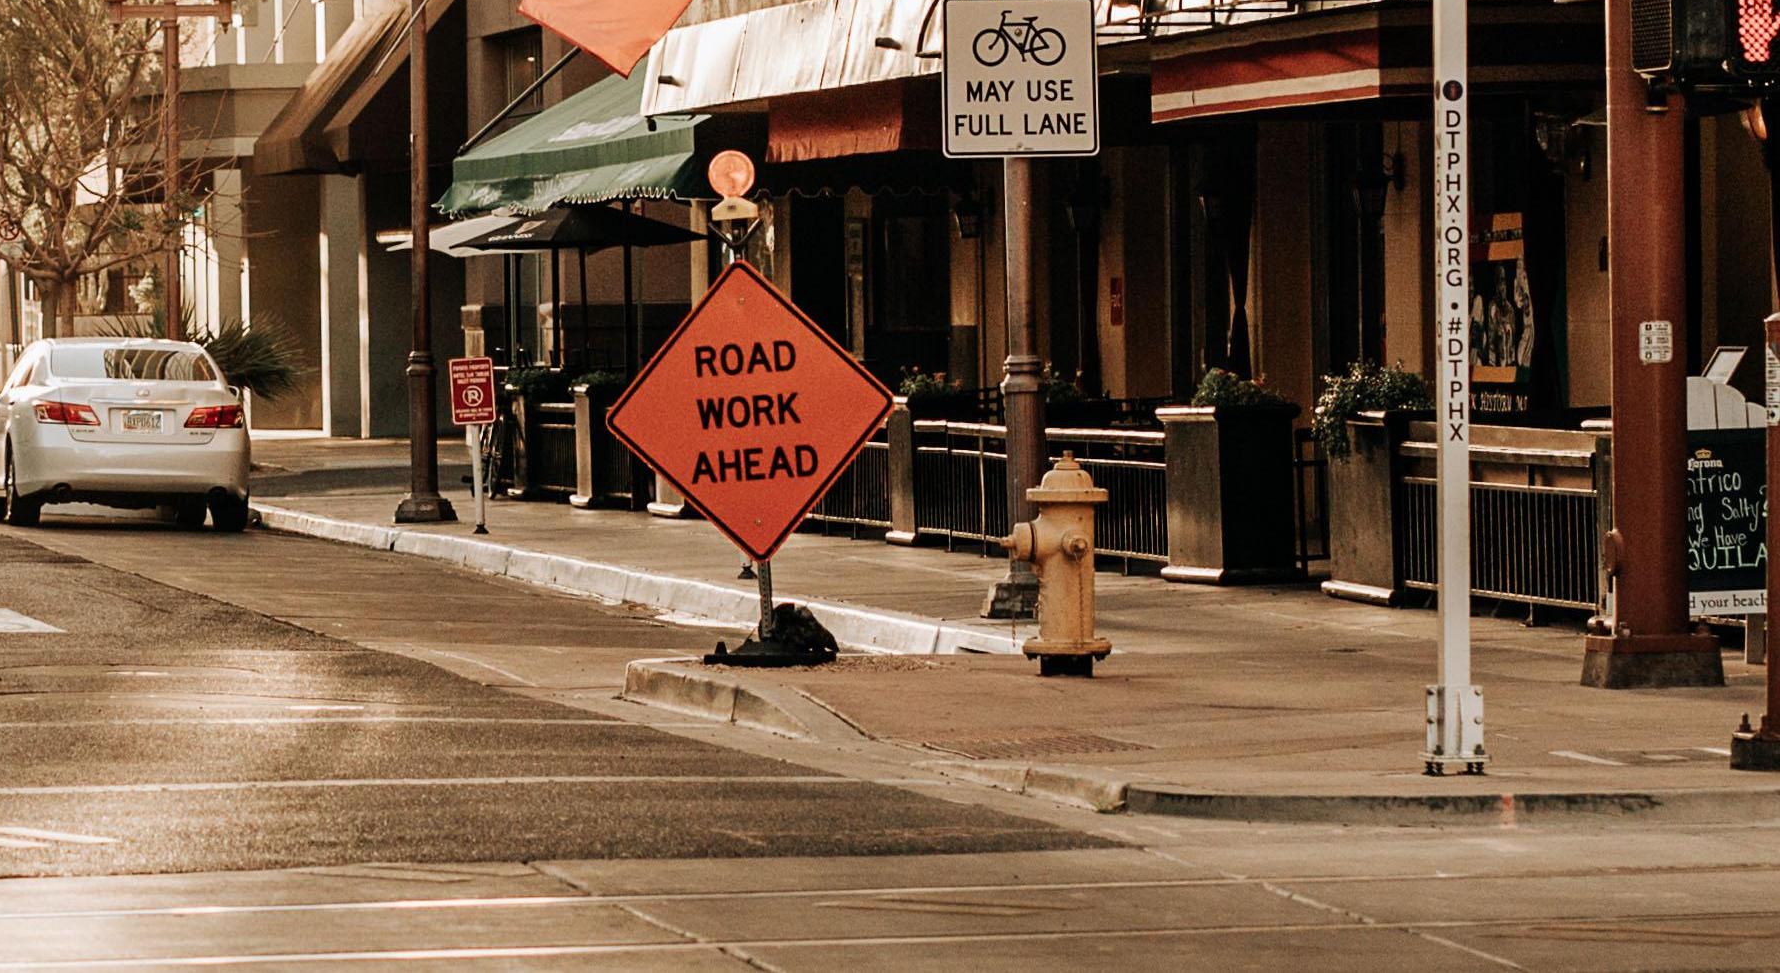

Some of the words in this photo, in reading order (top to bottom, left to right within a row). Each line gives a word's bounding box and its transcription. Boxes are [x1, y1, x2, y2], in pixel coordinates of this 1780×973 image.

[966, 80, 1015, 103] MAY
[1026, 79, 1074, 102] USE
[955, 114, 1013, 136] FULL
[1024, 113, 1088, 135] LANE
[694, 340, 797, 378] ROAD
[1447, 317, 1465, 442] #DTPHX
[696, 392, 802, 430] WORK
[691, 444, 819, 485] AHEAD
[1687, 457, 1724, 471] Corona
[1688, 534, 1709, 548] We
[1715, 525, 1748, 547] Have
[1688, 543, 1768, 571] QUILA
[1700, 598, 1730, 614] your
